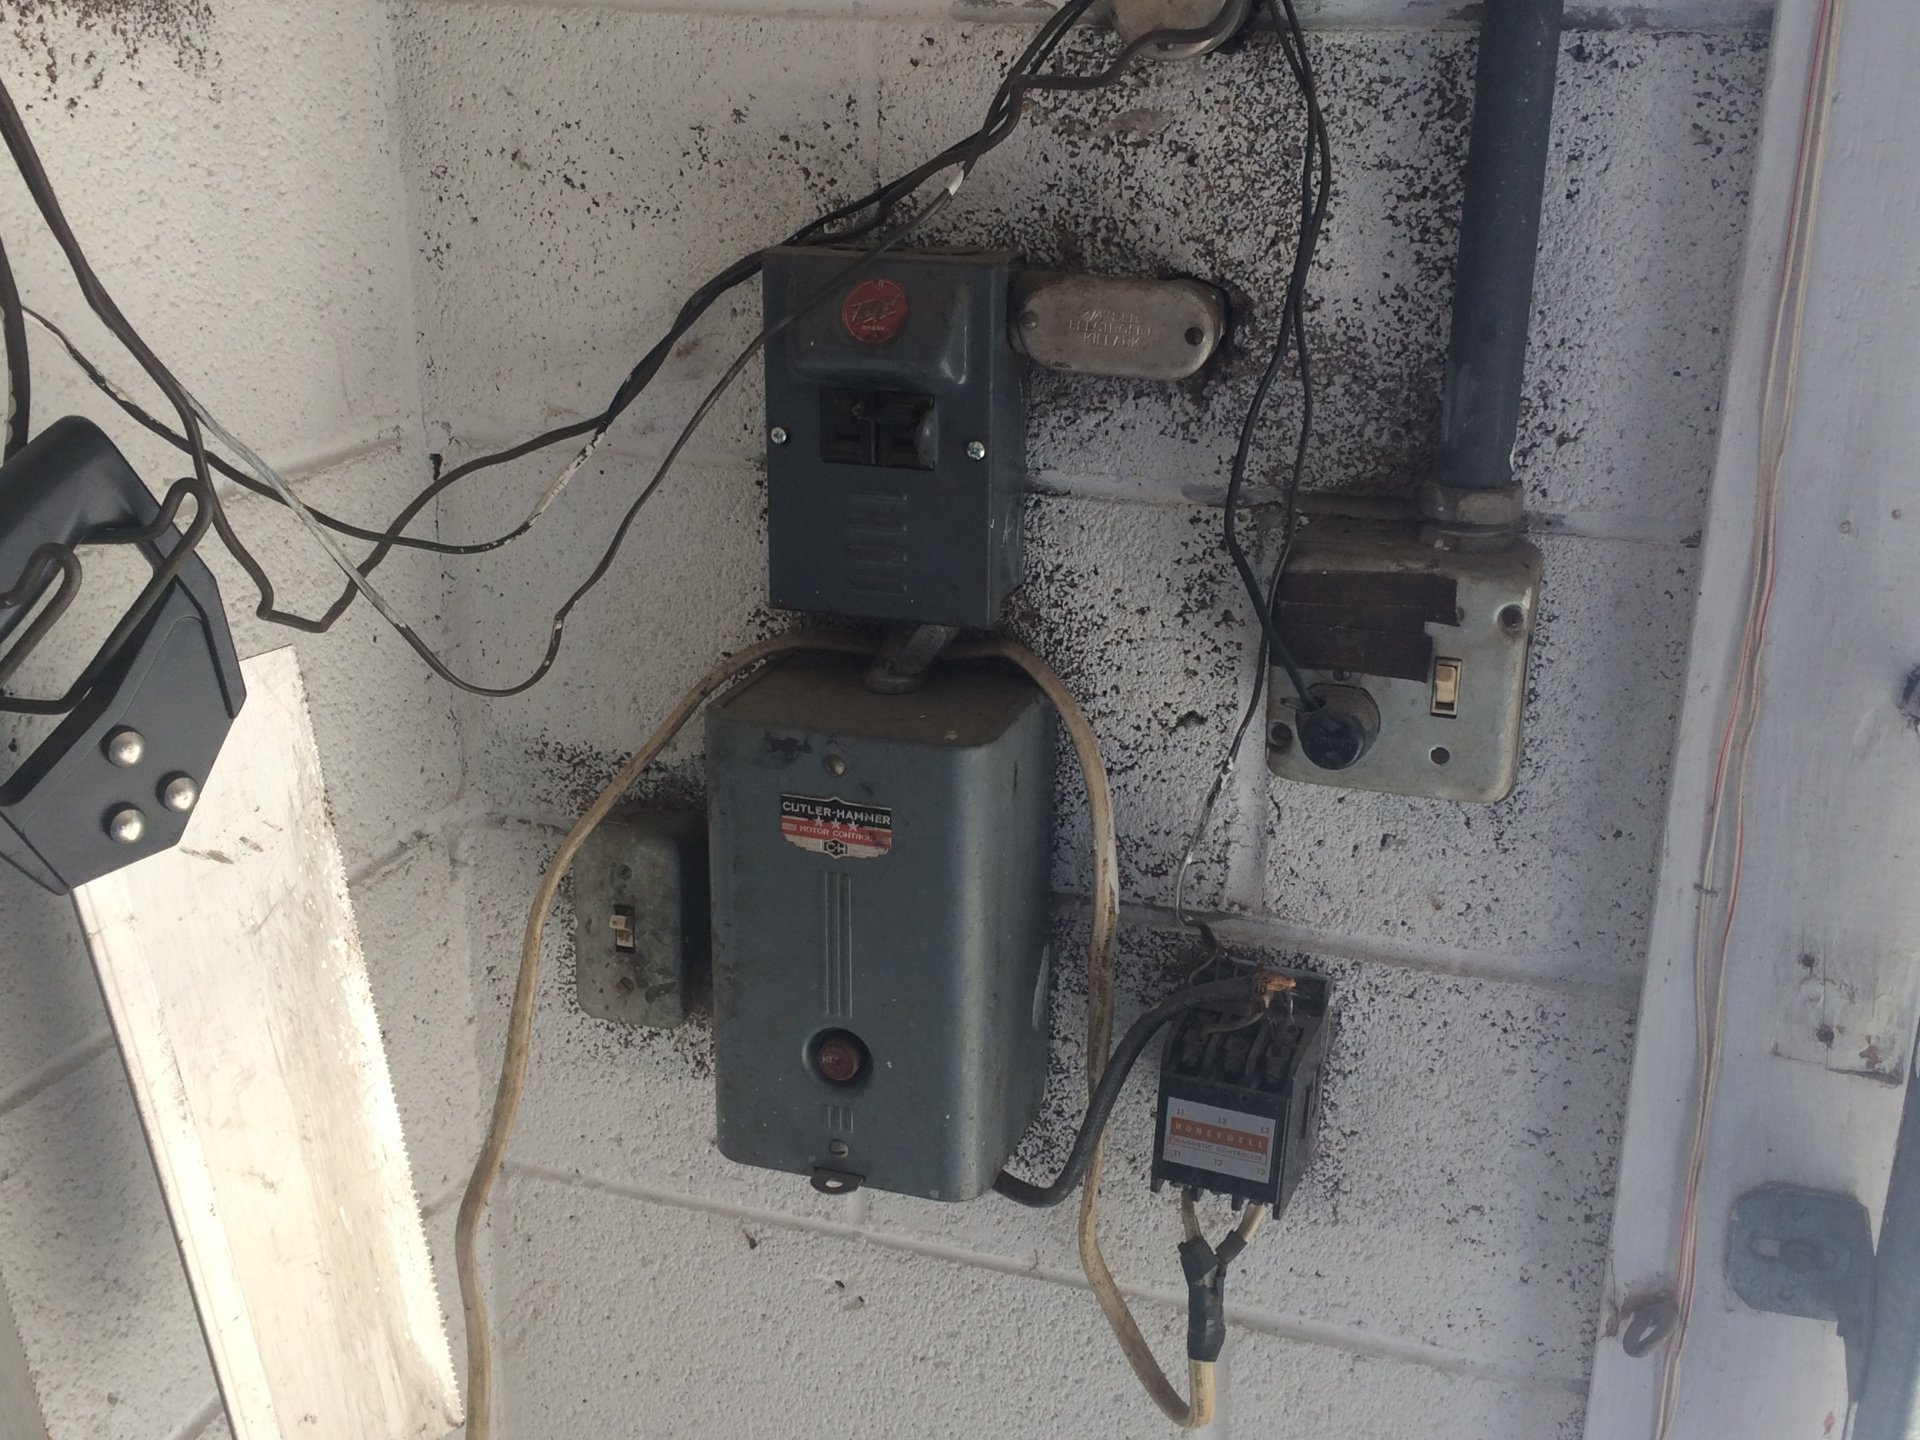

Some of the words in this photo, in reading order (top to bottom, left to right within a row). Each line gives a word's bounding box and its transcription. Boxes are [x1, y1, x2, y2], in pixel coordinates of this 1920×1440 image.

[782, 801, 890, 824] CUTLER-HAMMER
[799, 824, 830, 836] MOTOR
[832, 829, 873, 842] CONTROL
[1217, 1116, 1228, 1125] L2
[1175, 1122, 1264, 1149] HONEYWELL
[1212, 1158, 1224, 1167] T2
